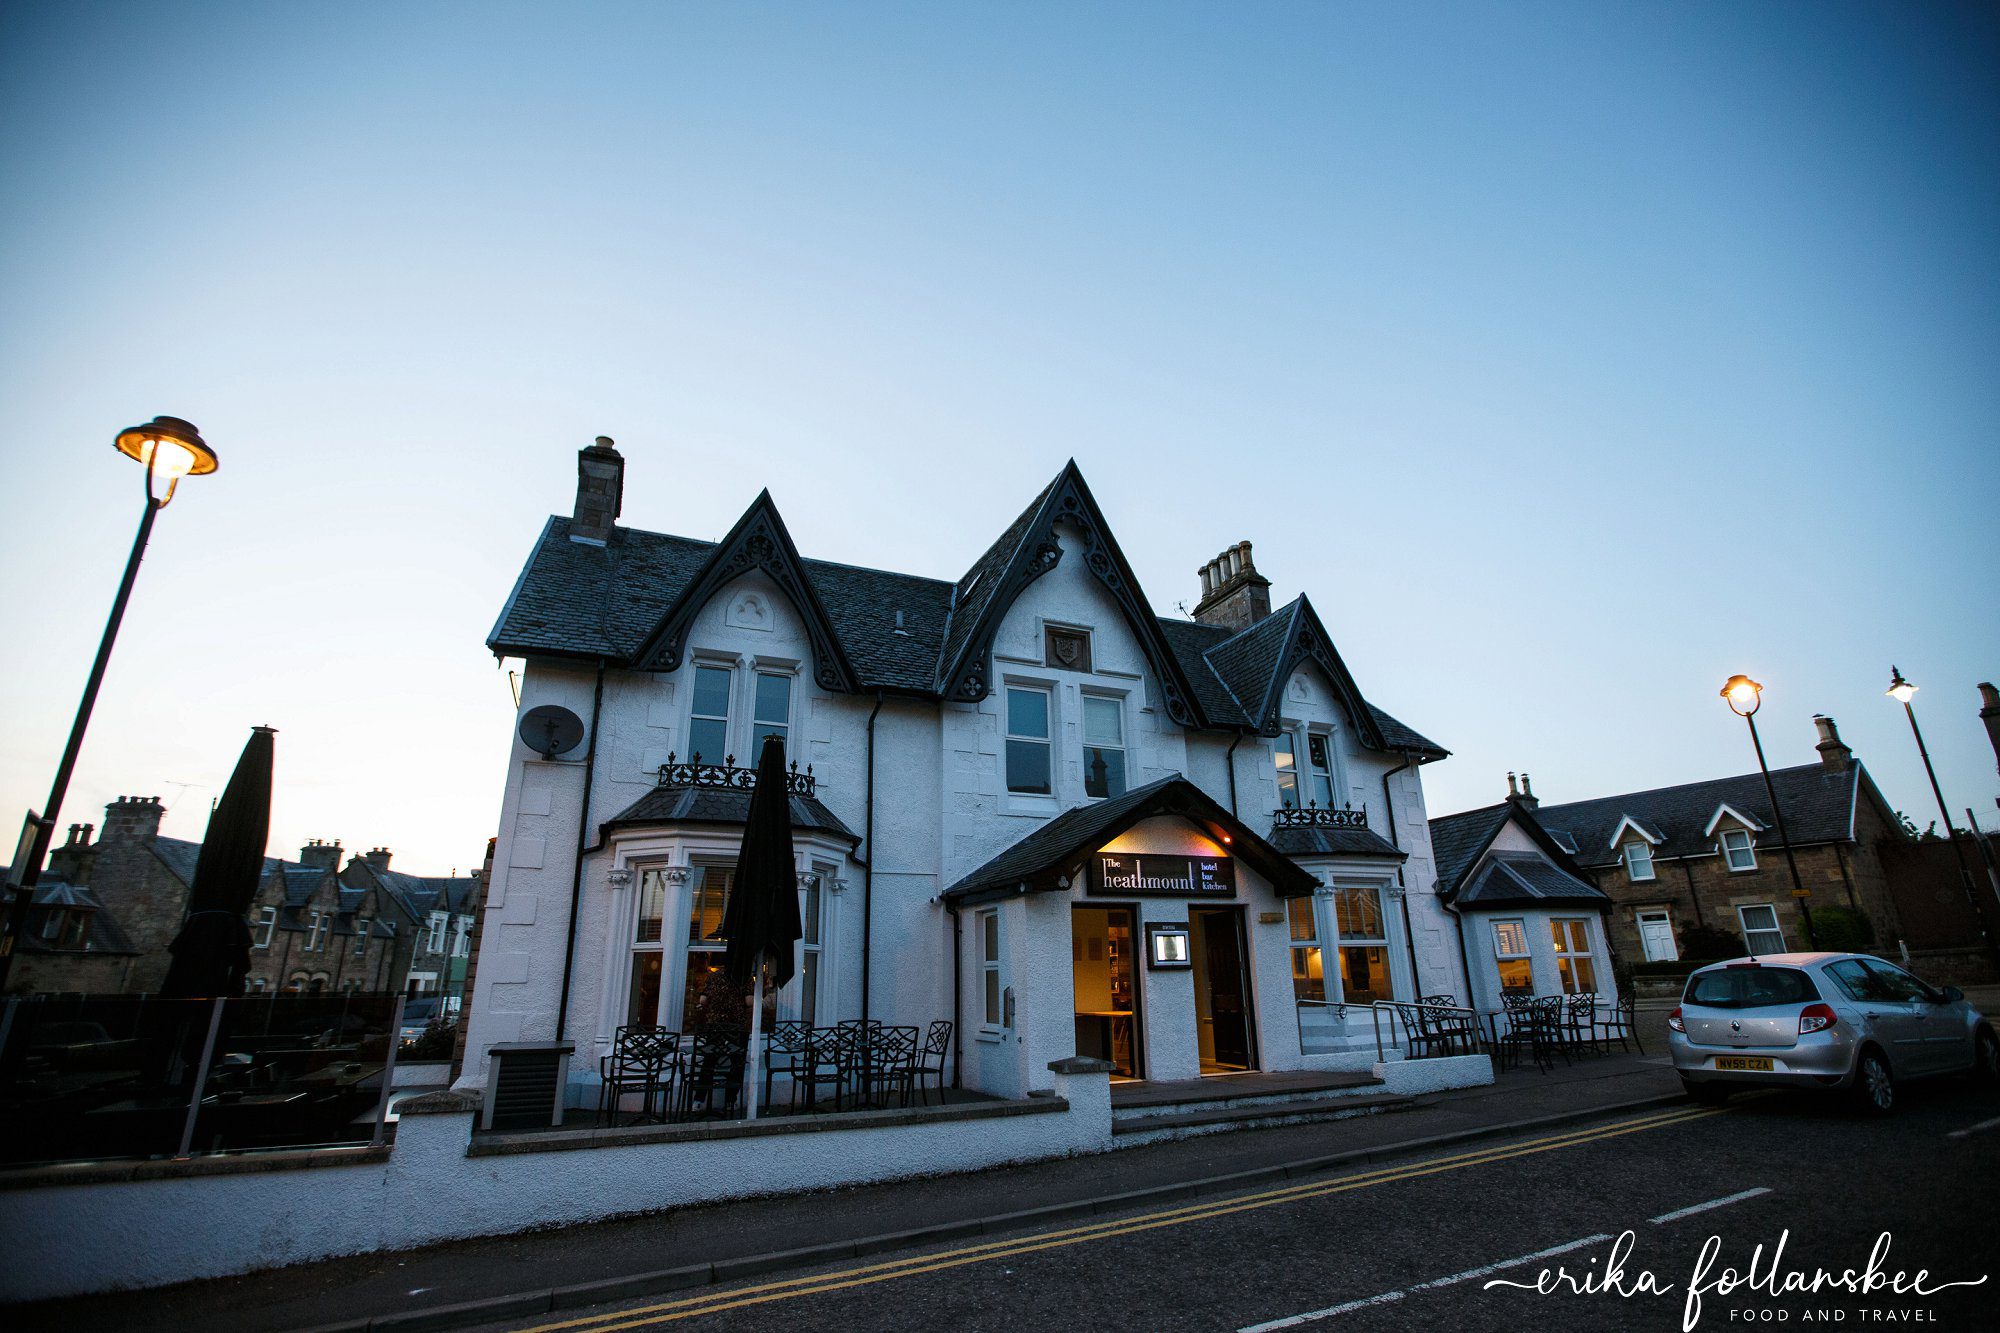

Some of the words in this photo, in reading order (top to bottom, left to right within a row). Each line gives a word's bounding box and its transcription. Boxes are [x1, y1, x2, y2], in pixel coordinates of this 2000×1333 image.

[1106, 858, 1120, 868] The
[1201, 862, 1217, 871] hotel
[1103, 858, 1195, 890] heathmount
[1201, 871, 1213, 880] bar
[1202, 881, 1227, 890] kitchen
[1719, 1059, 1746, 1069] NV59
[1748, 1059, 1770, 1070] CZA
